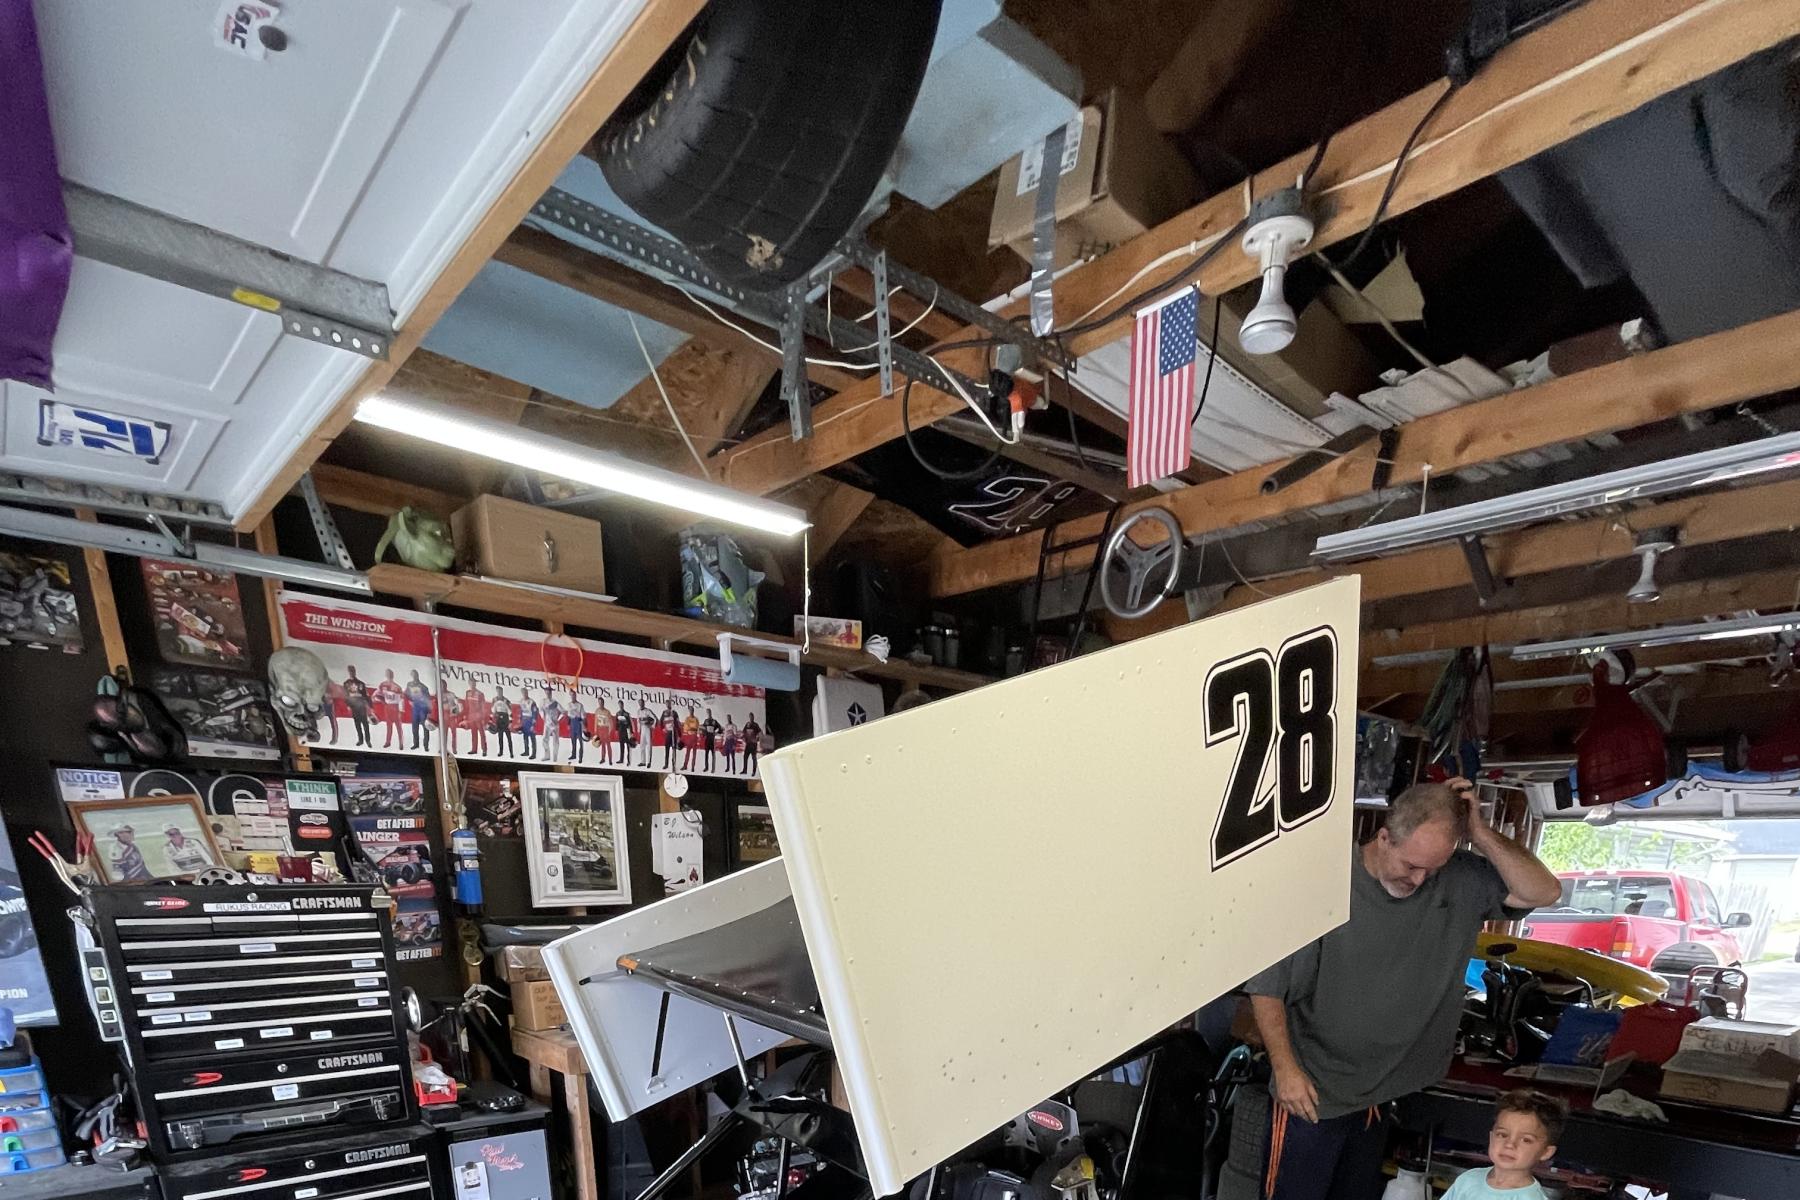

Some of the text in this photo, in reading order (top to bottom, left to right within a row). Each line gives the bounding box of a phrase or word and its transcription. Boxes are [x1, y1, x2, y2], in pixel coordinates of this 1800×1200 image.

[304, 612, 386, 633] THE WINSTON
[442, 663, 491, 685] When
[495, 671, 527, 688] the
[523, 678, 568, 694] green
[616, 686, 639, 701] the
[640, 687, 669, 706] bull
[670, 691, 702, 709] stops
[1203, 624, 1338, 872] 28
[62, 770, 118, 784] NOTICE
[293, 782, 331, 794] THINK
[377, 819, 392, 829] GET
[392, 818, 415, 829] AFTER
[292, 896, 362, 909] CRAFTSMAN
[410, 948, 432, 959] AFTER
[317, 1052, 384, 1069] CRAFTSMAN
[345, 1143, 411, 1163] CRAFTSMAN
